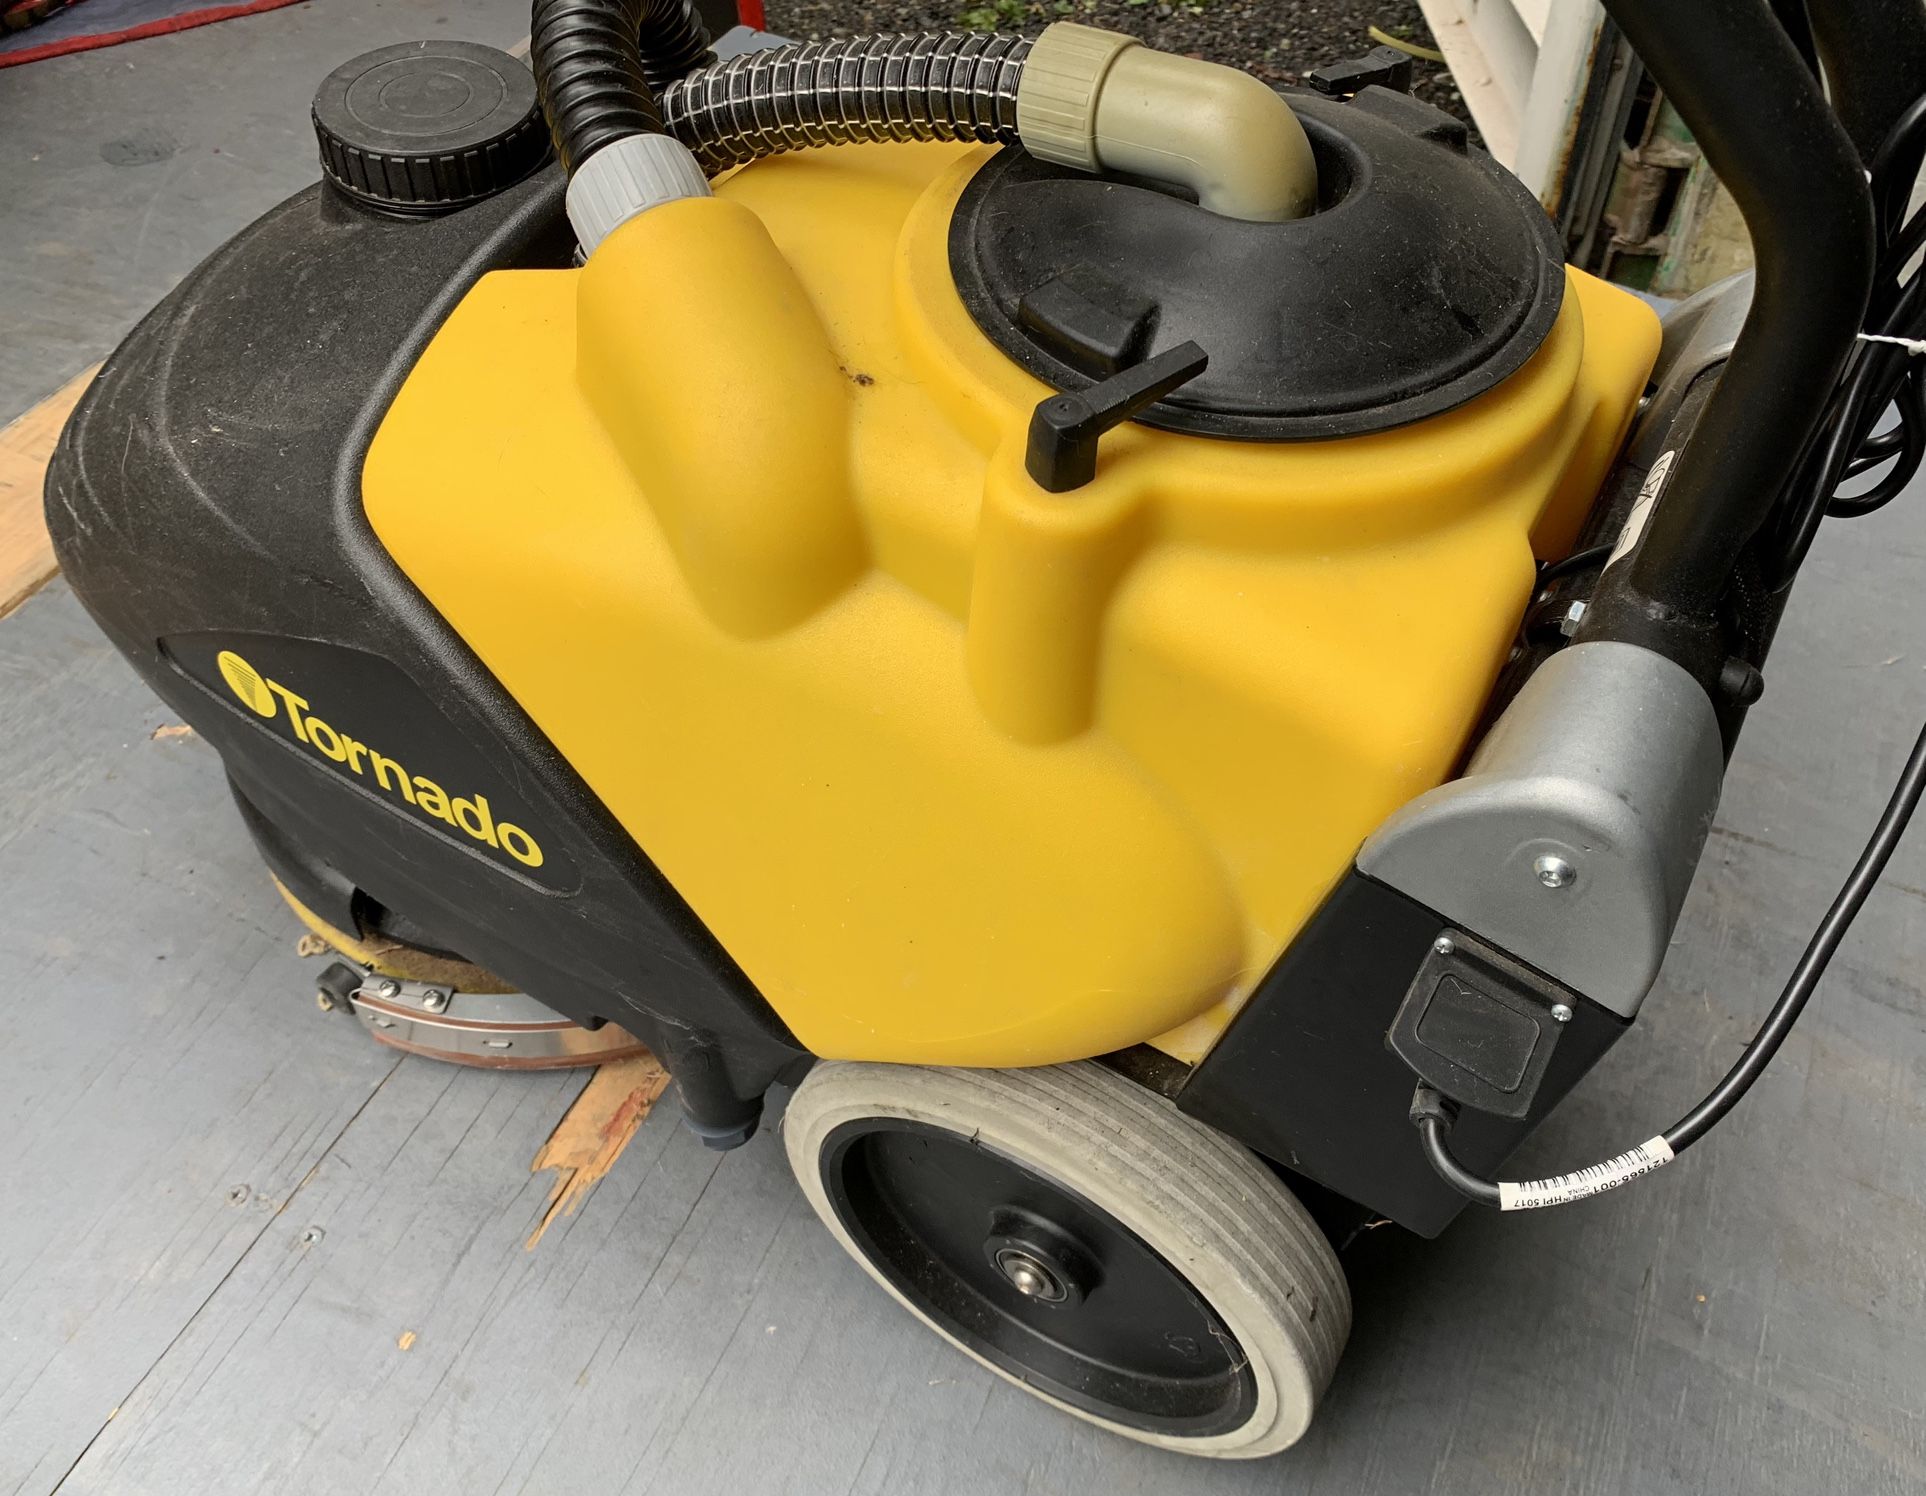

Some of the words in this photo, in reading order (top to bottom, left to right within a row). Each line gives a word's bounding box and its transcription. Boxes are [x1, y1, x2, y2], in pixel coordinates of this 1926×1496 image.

[266, 678, 544, 867] Tornado
[1568, 1185, 1590, 1196] CHINA
[1514, 1199, 1540, 1208] 5017
